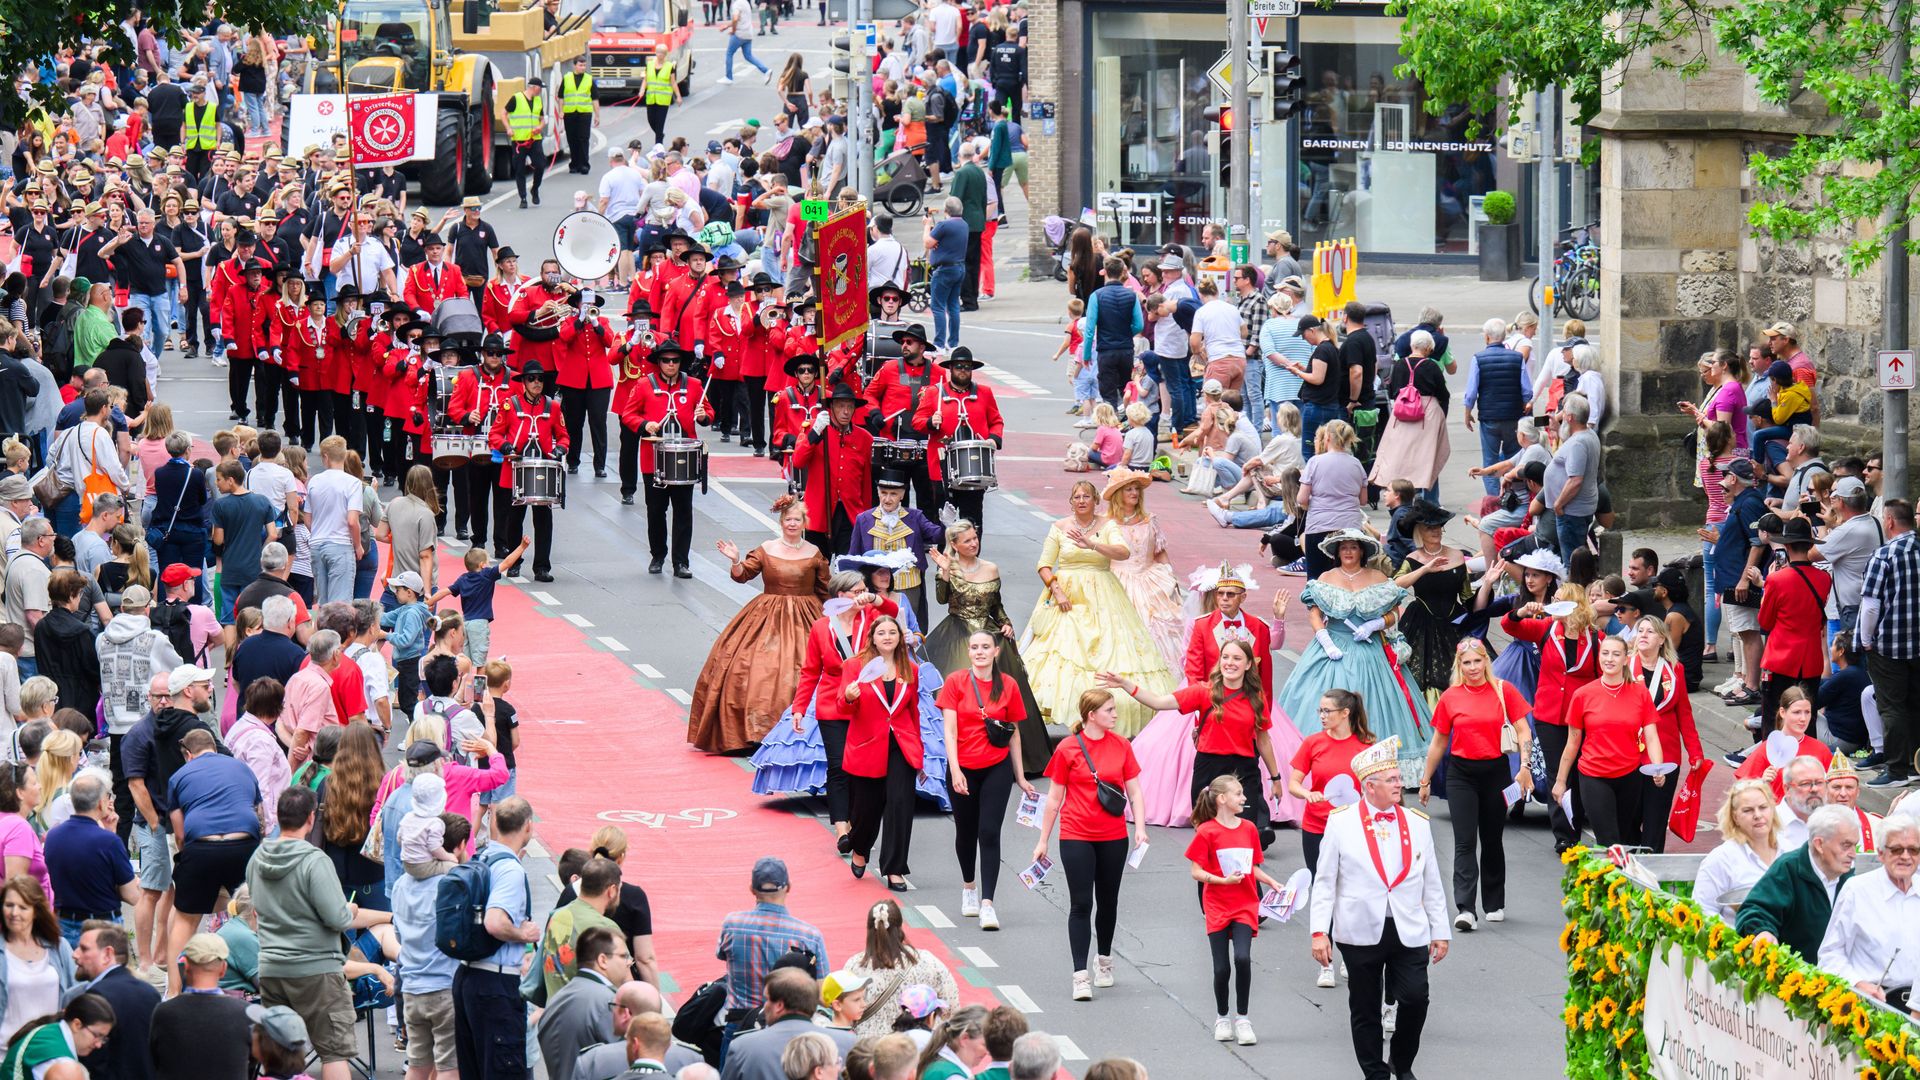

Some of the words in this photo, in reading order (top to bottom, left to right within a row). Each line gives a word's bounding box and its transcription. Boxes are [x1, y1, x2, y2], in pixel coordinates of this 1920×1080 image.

[1254, 1, 1276, 11] Breite
[1279, 1, 1292, 11] Str.
[1302, 139, 1369, 149] GARDINEN
[1386, 141, 1493, 152] SONNENSCHUTZ
[804, 205, 823, 216] 041
[1746, 1006, 1798, 1071] Hannover
